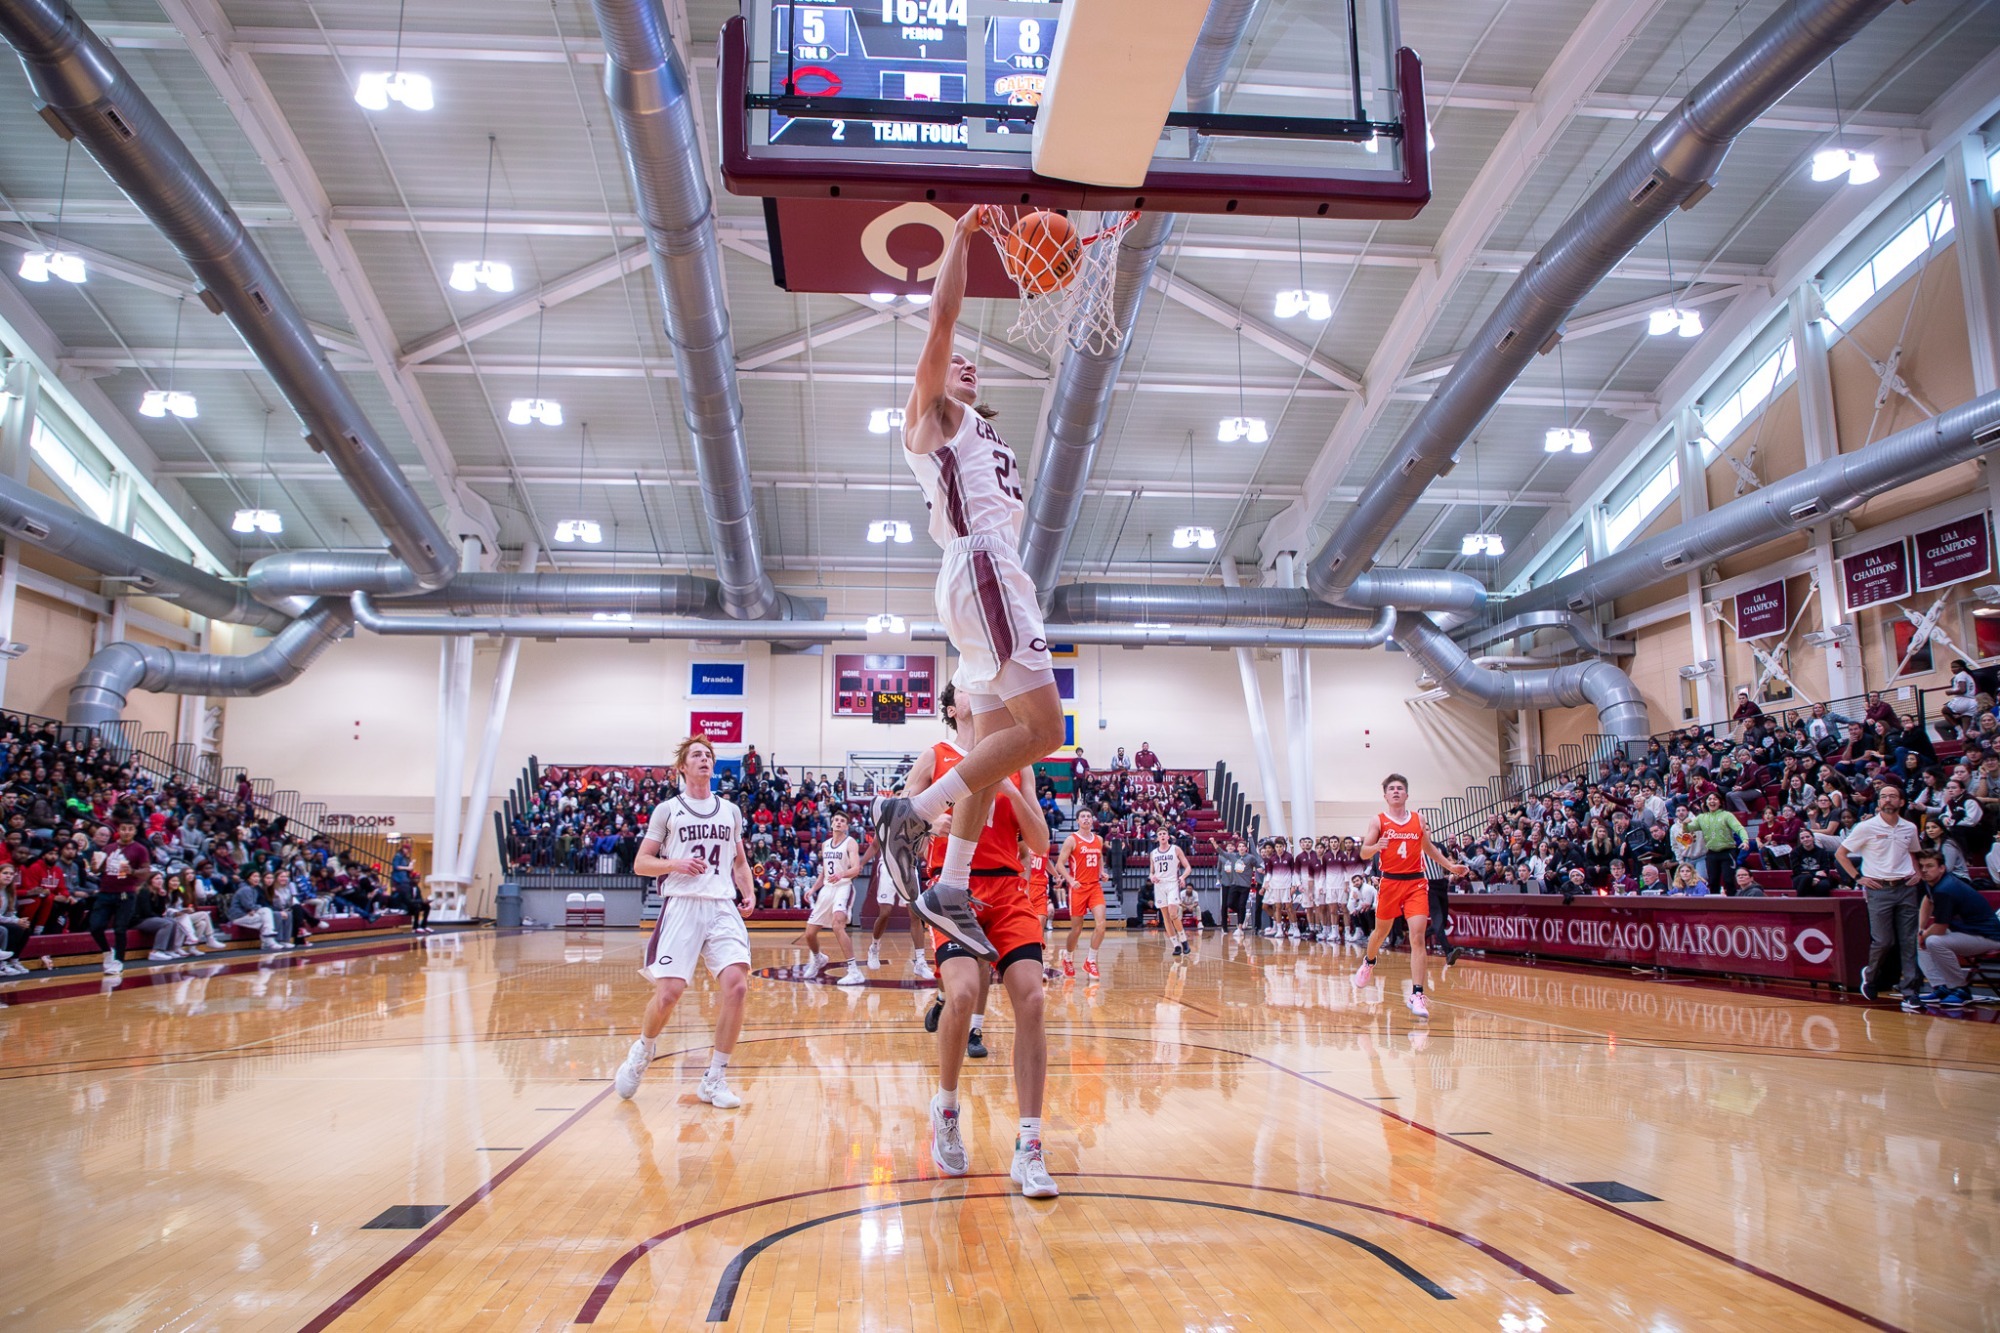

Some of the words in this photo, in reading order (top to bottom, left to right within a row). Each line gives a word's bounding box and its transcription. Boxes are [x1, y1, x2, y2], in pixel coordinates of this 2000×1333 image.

[882, 0, 967, 26] 16:44
[802, 9, 825, 45] 5
[902, 26, 943, 41] PERIOD
[1018, 19, 1040, 54] 8
[919, 44, 926, 58] 1
[997, 76, 1045, 92] CALTE
[832, 120, 845, 141] 2
[872, 122, 917, 142] TEAM
[921, 124, 968, 144] FOULS
[1926, 535, 1977, 559] CHAMPIONS
[1852, 561, 1898, 582] CHAMPIONS
[1743, 599, 1779, 615] CHAMPIONS
[878, 693, 903, 704] 16:44
[700, 719, 733, 728] Carnegie
[704, 728, 728, 736] Mellon
[318, 814, 395, 827] RESTROOMS
[679, 823, 731, 843] CHICAGO
[1386, 828, 1419, 840] Beavers
[1397, 841, 1407, 859] 4
[1031, 856, 1042, 870] 30
[1086, 854, 1098, 867] 23
[1154, 854, 1174, 862] CHICAGO
[827, 861, 835, 875] 3
[1159, 862, 1169, 873] 13
[1456, 914, 1540, 942] UNIVERSITY
[1542, 917, 1564, 944] OF
[1567, 919, 1655, 951] CHICAGO
[1657, 922, 1788, 961] MAROONS
